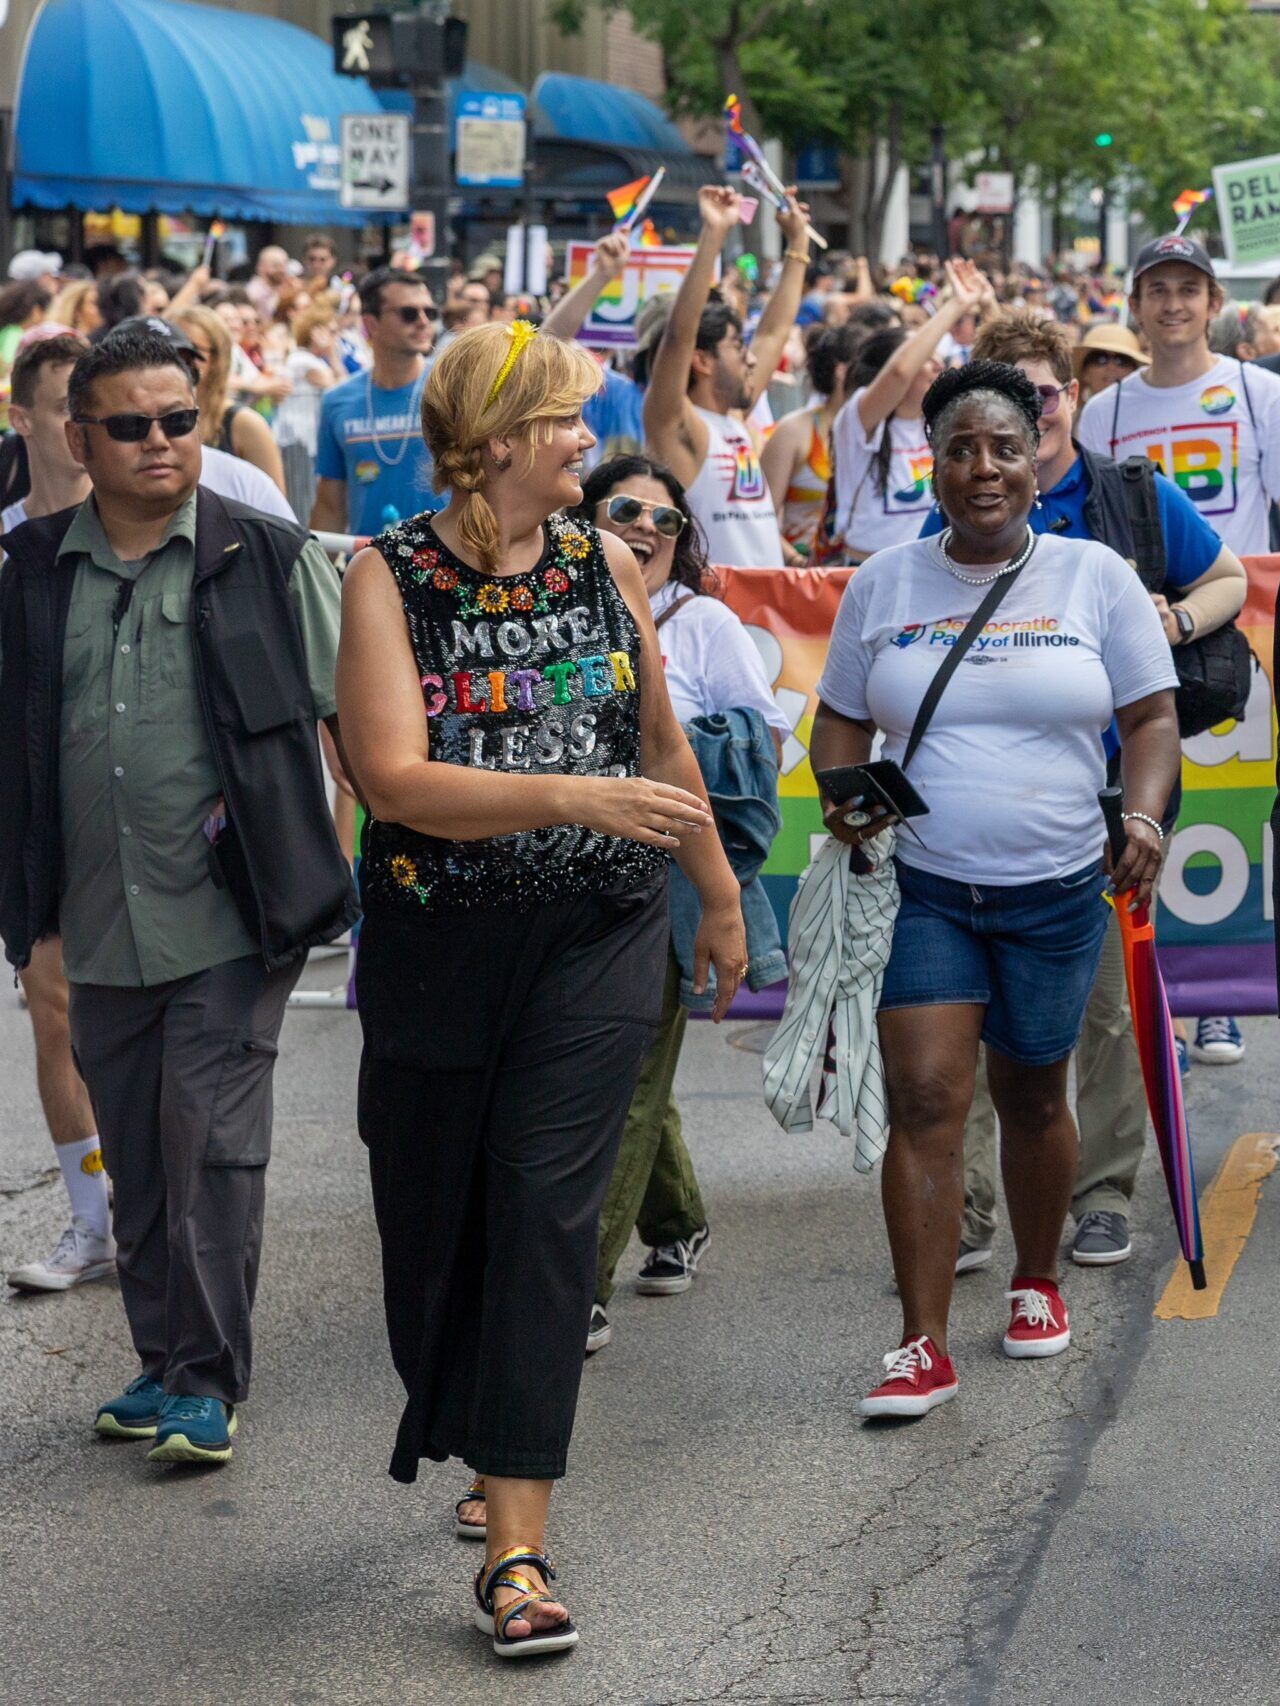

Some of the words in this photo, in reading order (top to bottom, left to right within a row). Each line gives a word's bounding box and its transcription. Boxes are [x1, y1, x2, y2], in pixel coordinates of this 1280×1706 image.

[350, 122, 398, 140] ONE
[350, 144, 399, 166] WAY
[450, 606, 599, 658] MORE
[934, 616, 1059, 634] Deocratic
[991, 636, 1010, 648] of
[1013, 631, 1080, 648] Illinois
[421, 650, 636, 717] GLITTER
[467, 713, 598, 770] LESS
